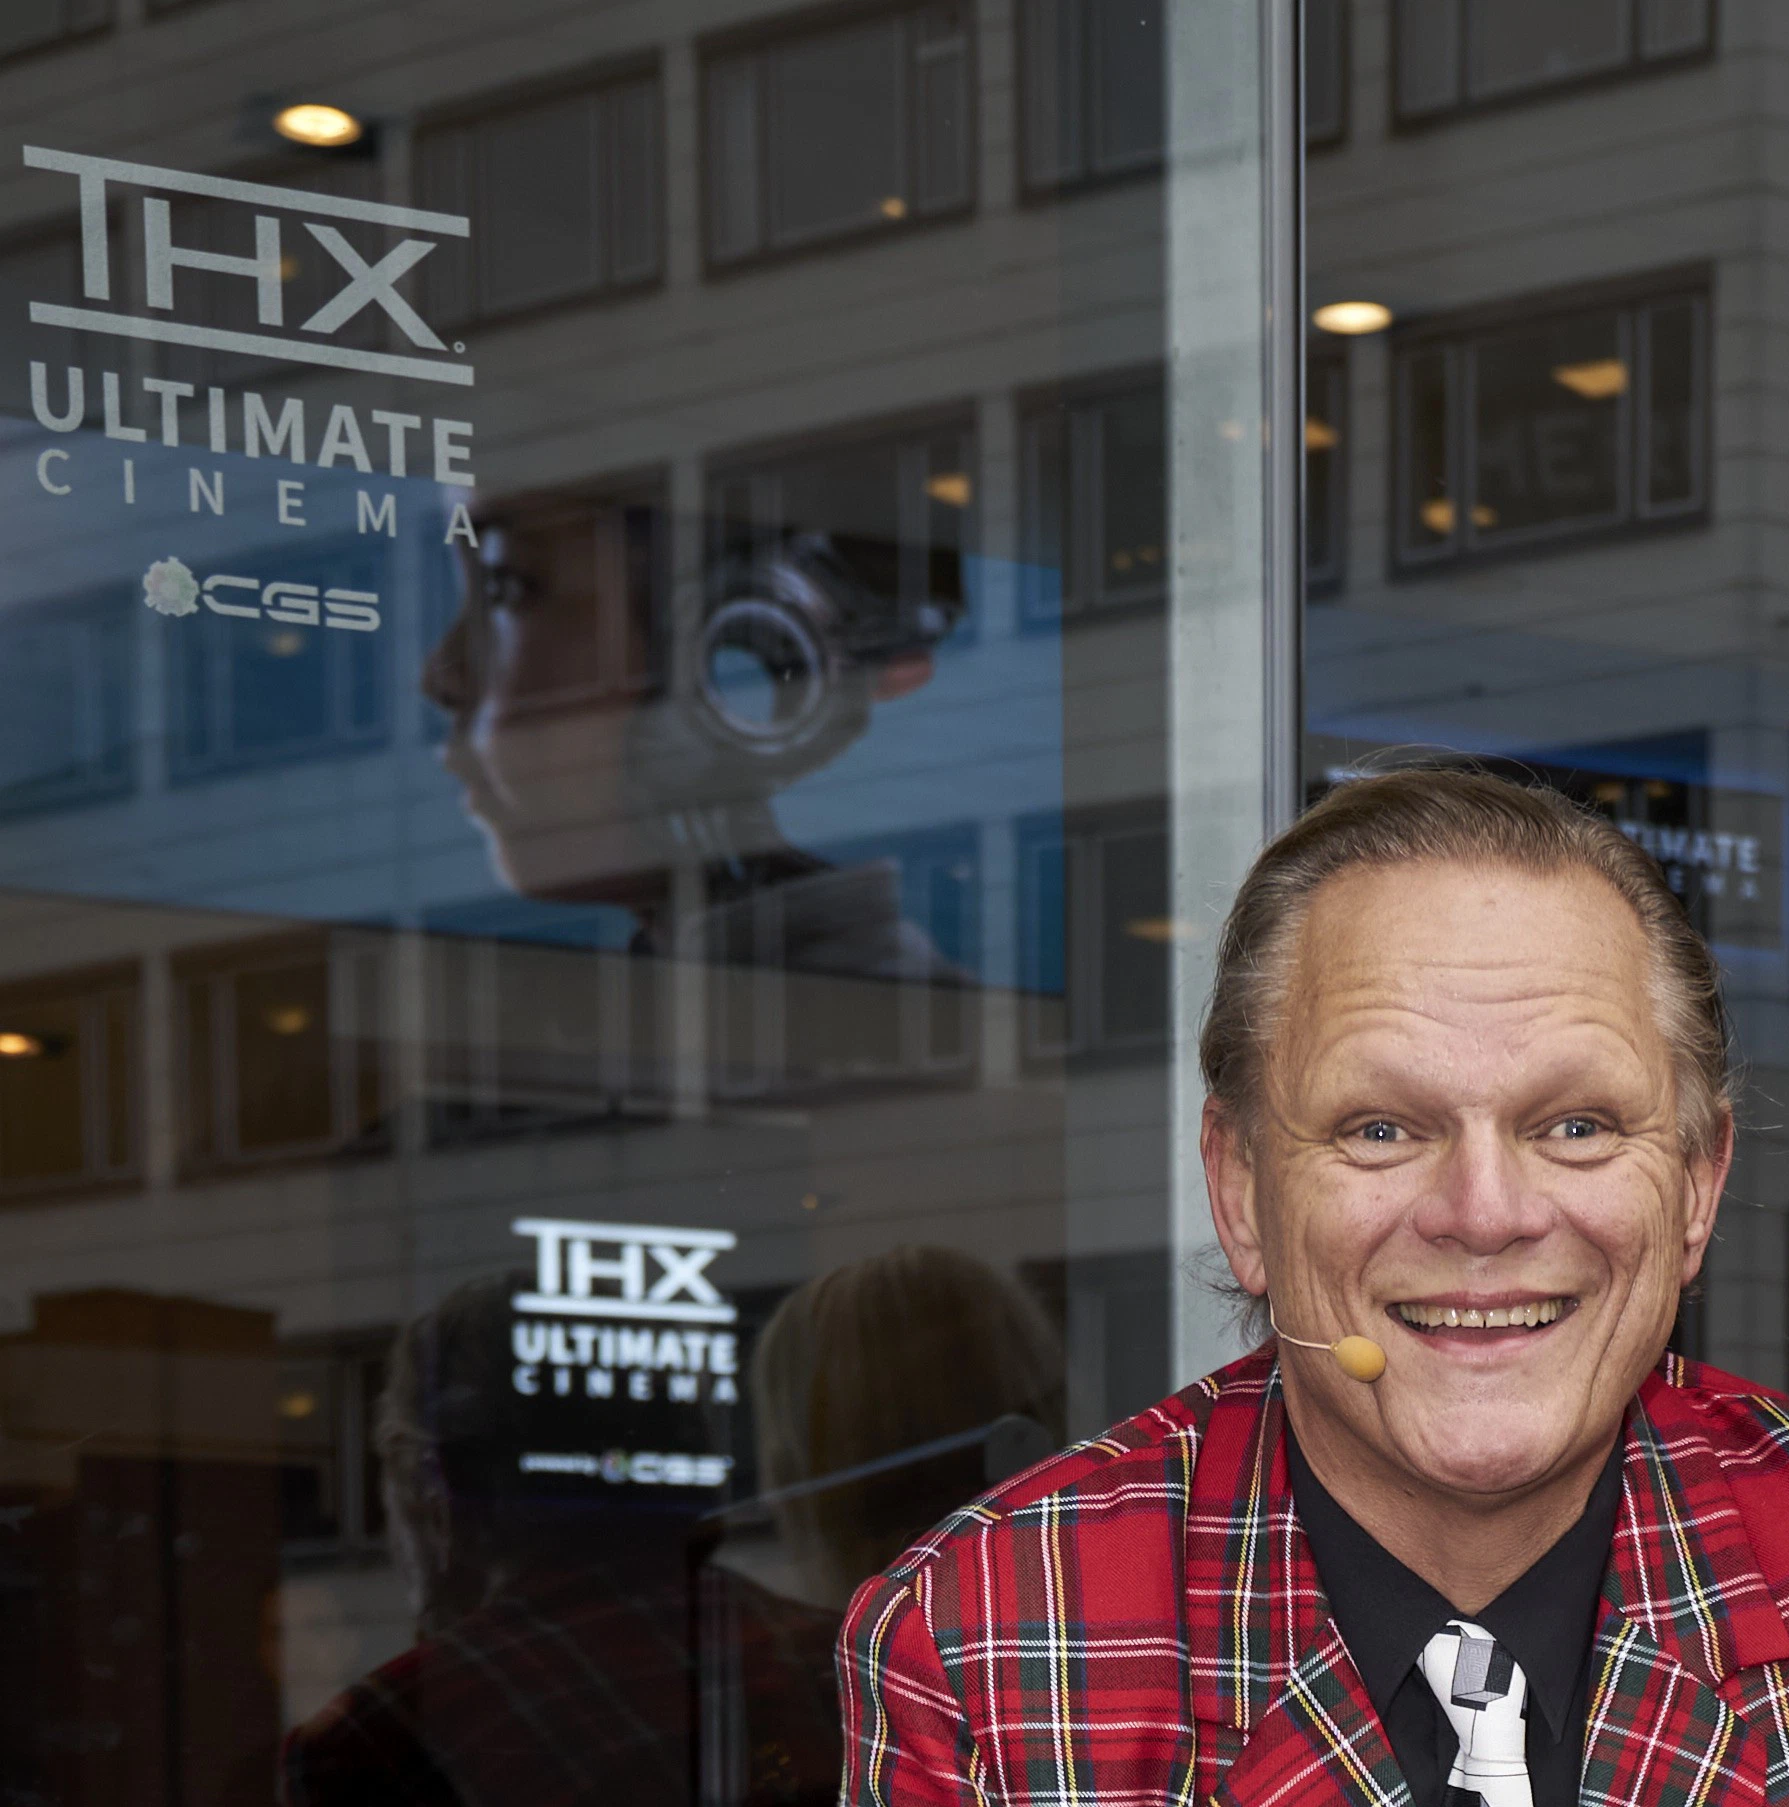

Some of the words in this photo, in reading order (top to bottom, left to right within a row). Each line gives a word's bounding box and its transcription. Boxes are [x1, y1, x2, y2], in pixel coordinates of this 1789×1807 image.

[23, 144, 474, 352] THX
[30, 361, 476, 487] ULTIMATE
[36, 448, 480, 548] CINEMA
[202, 574, 381, 632] CGS
[511, 1217, 737, 1304] THX
[511, 1321, 737, 1375] ULTIMATE
